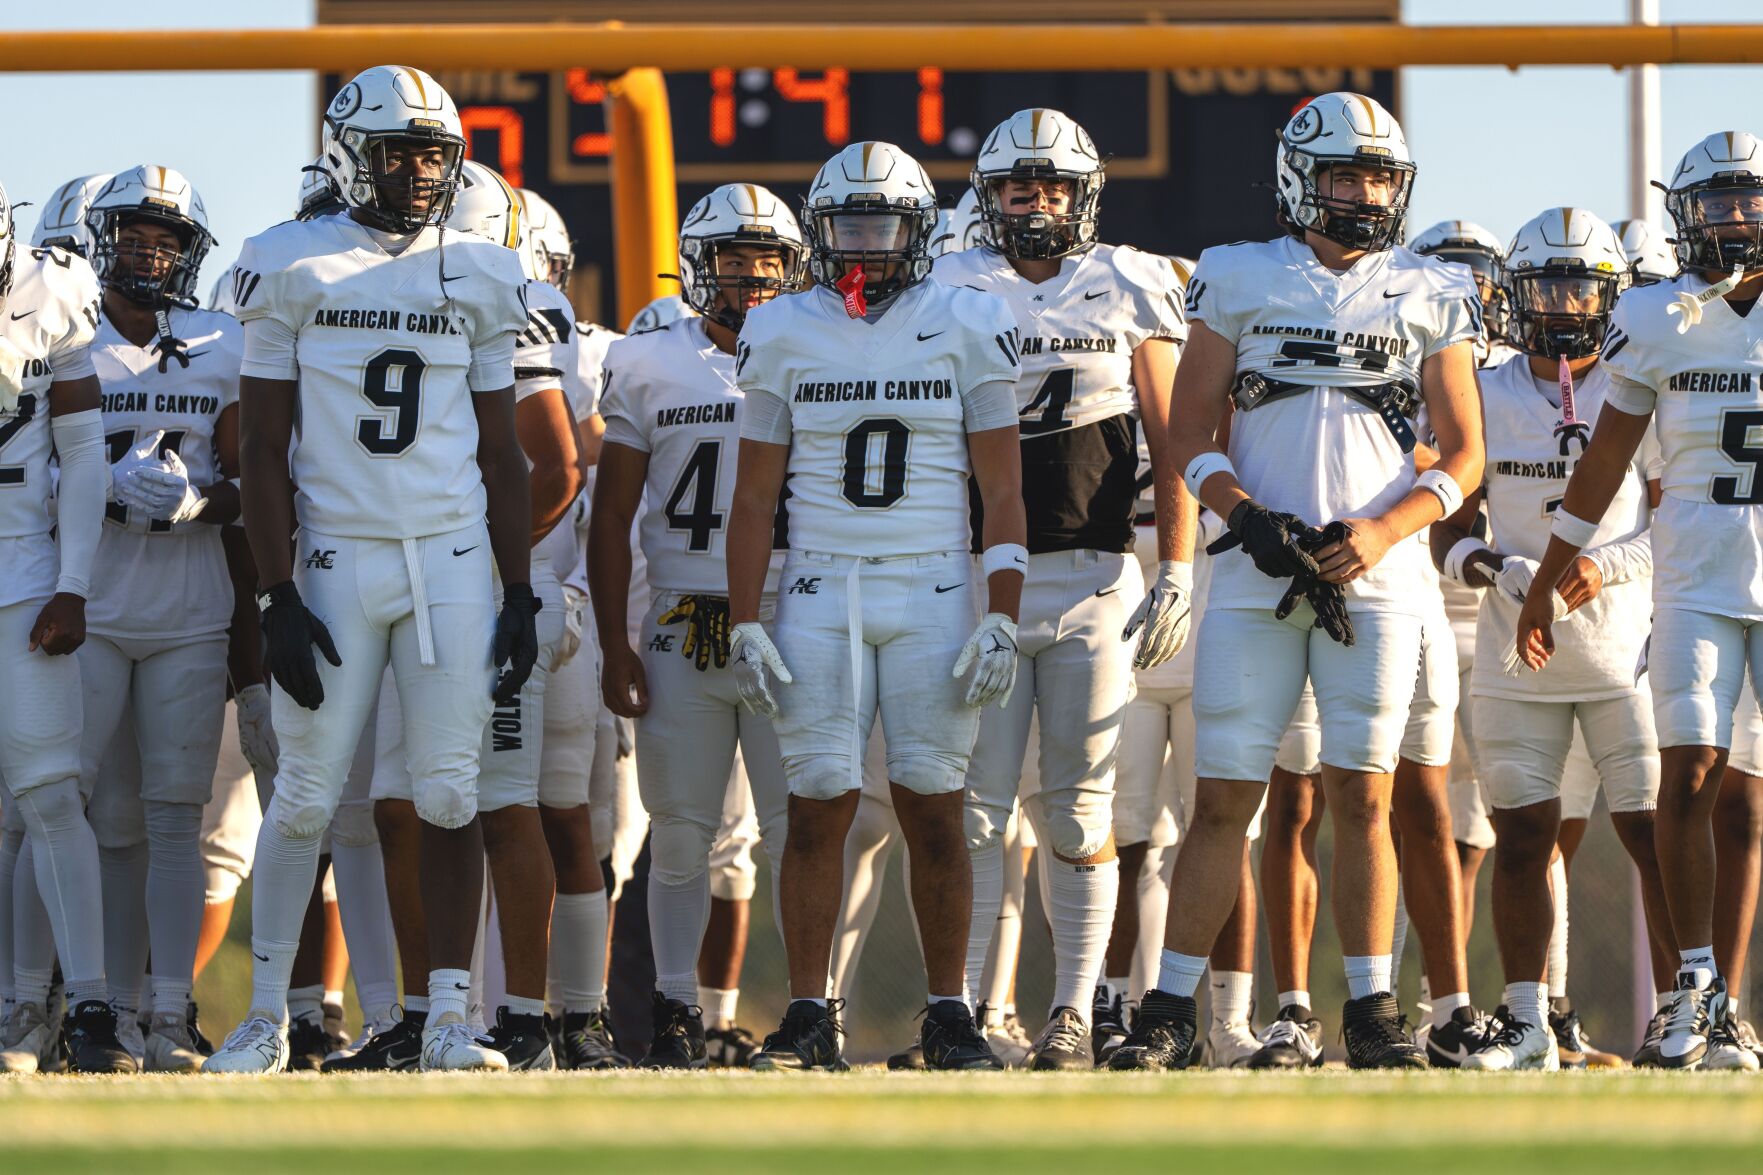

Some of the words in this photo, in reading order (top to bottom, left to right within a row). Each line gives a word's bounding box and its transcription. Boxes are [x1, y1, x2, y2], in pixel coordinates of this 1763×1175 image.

[314, 309, 400, 331] AMERICAN
[406, 313, 465, 335] CANY
[1050, 337, 1117, 353] CANYON
[795, 381, 876, 403] AMERICAN
[884, 379, 952, 400] CANYON
[1669, 372, 1751, 393] AMERICAN
[101, 392, 147, 413] RICAN
[155, 394, 218, 415] CANYON
[354, 345, 430, 458] 9
[657, 402, 736, 428] AMERICAN
[840, 415, 915, 511] 0
